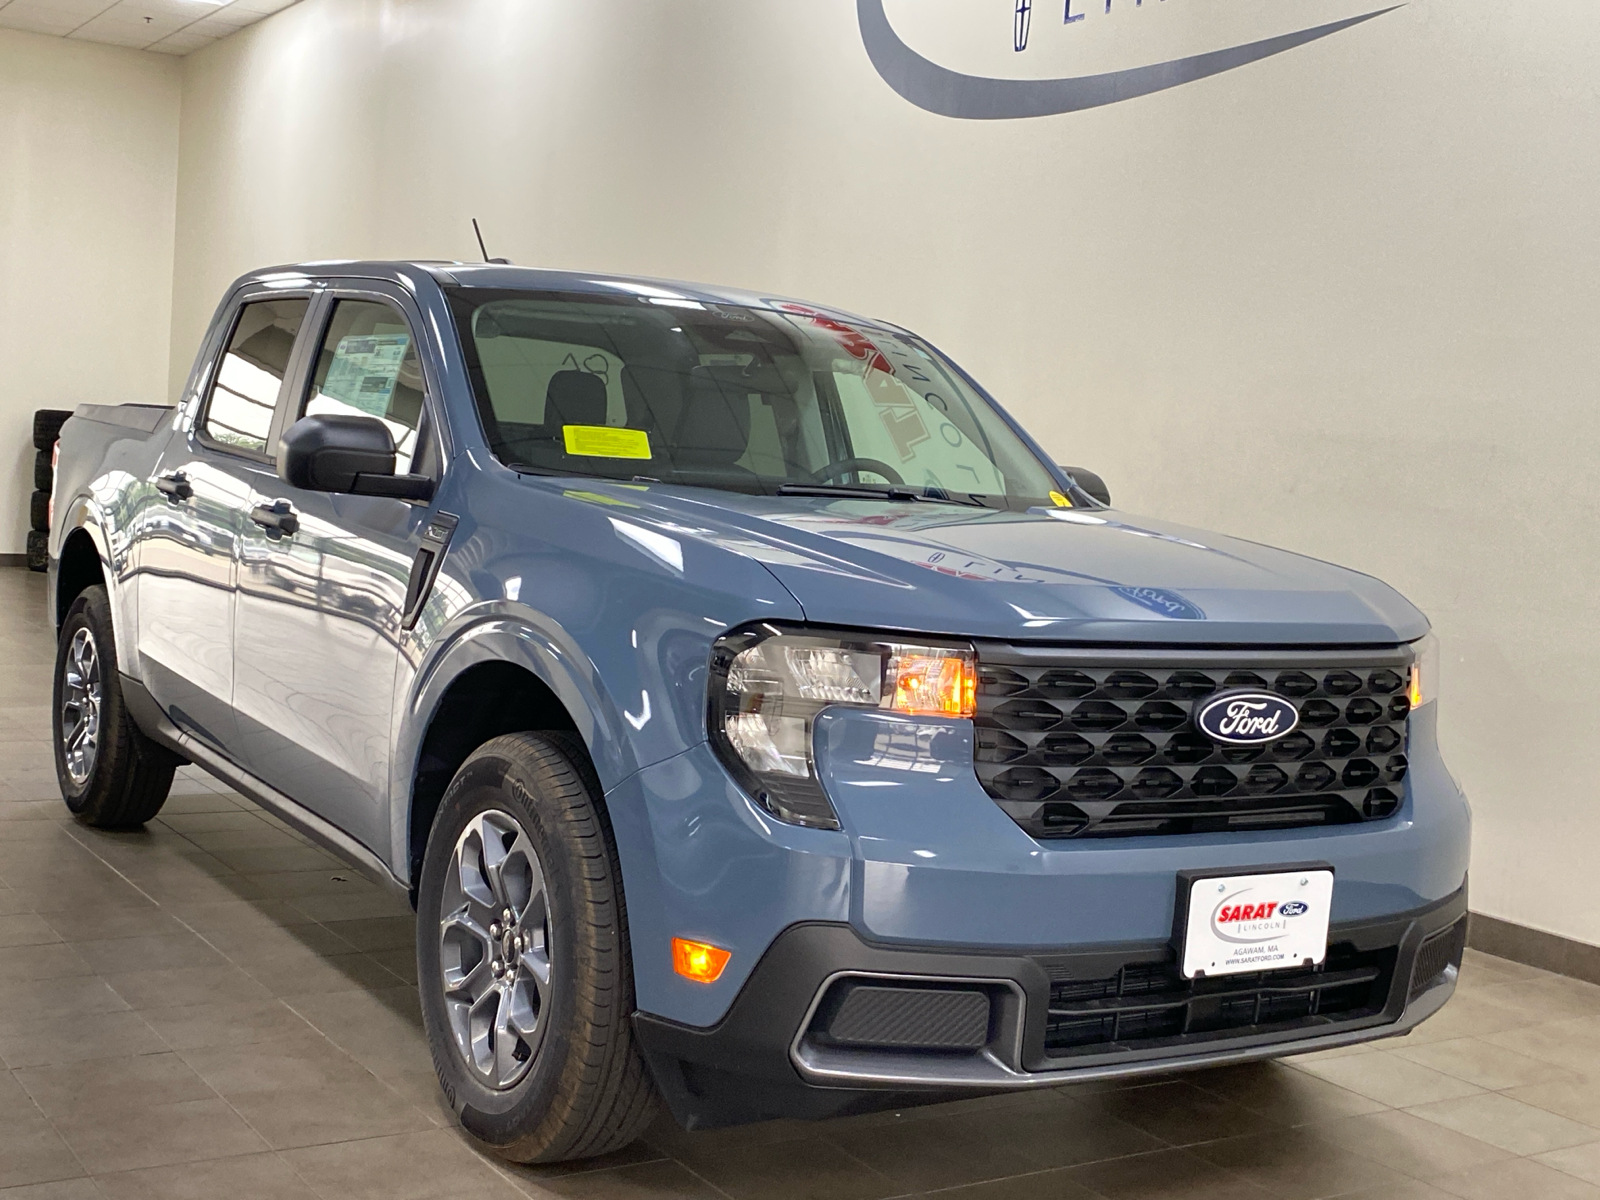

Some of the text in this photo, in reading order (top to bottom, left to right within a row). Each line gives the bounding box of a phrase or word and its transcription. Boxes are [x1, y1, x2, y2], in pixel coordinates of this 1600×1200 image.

[721, 311, 748, 320] Ford
[1220, 701, 1281, 734] Ford
[1218, 902, 1304, 923] SARAT Ford
[1243, 922, 1281, 931] LINCOLN
[1233, 945, 1279, 956] AGAWAM, MA
[1225, 953, 1285, 965] WWW.SARATFORD.COM
